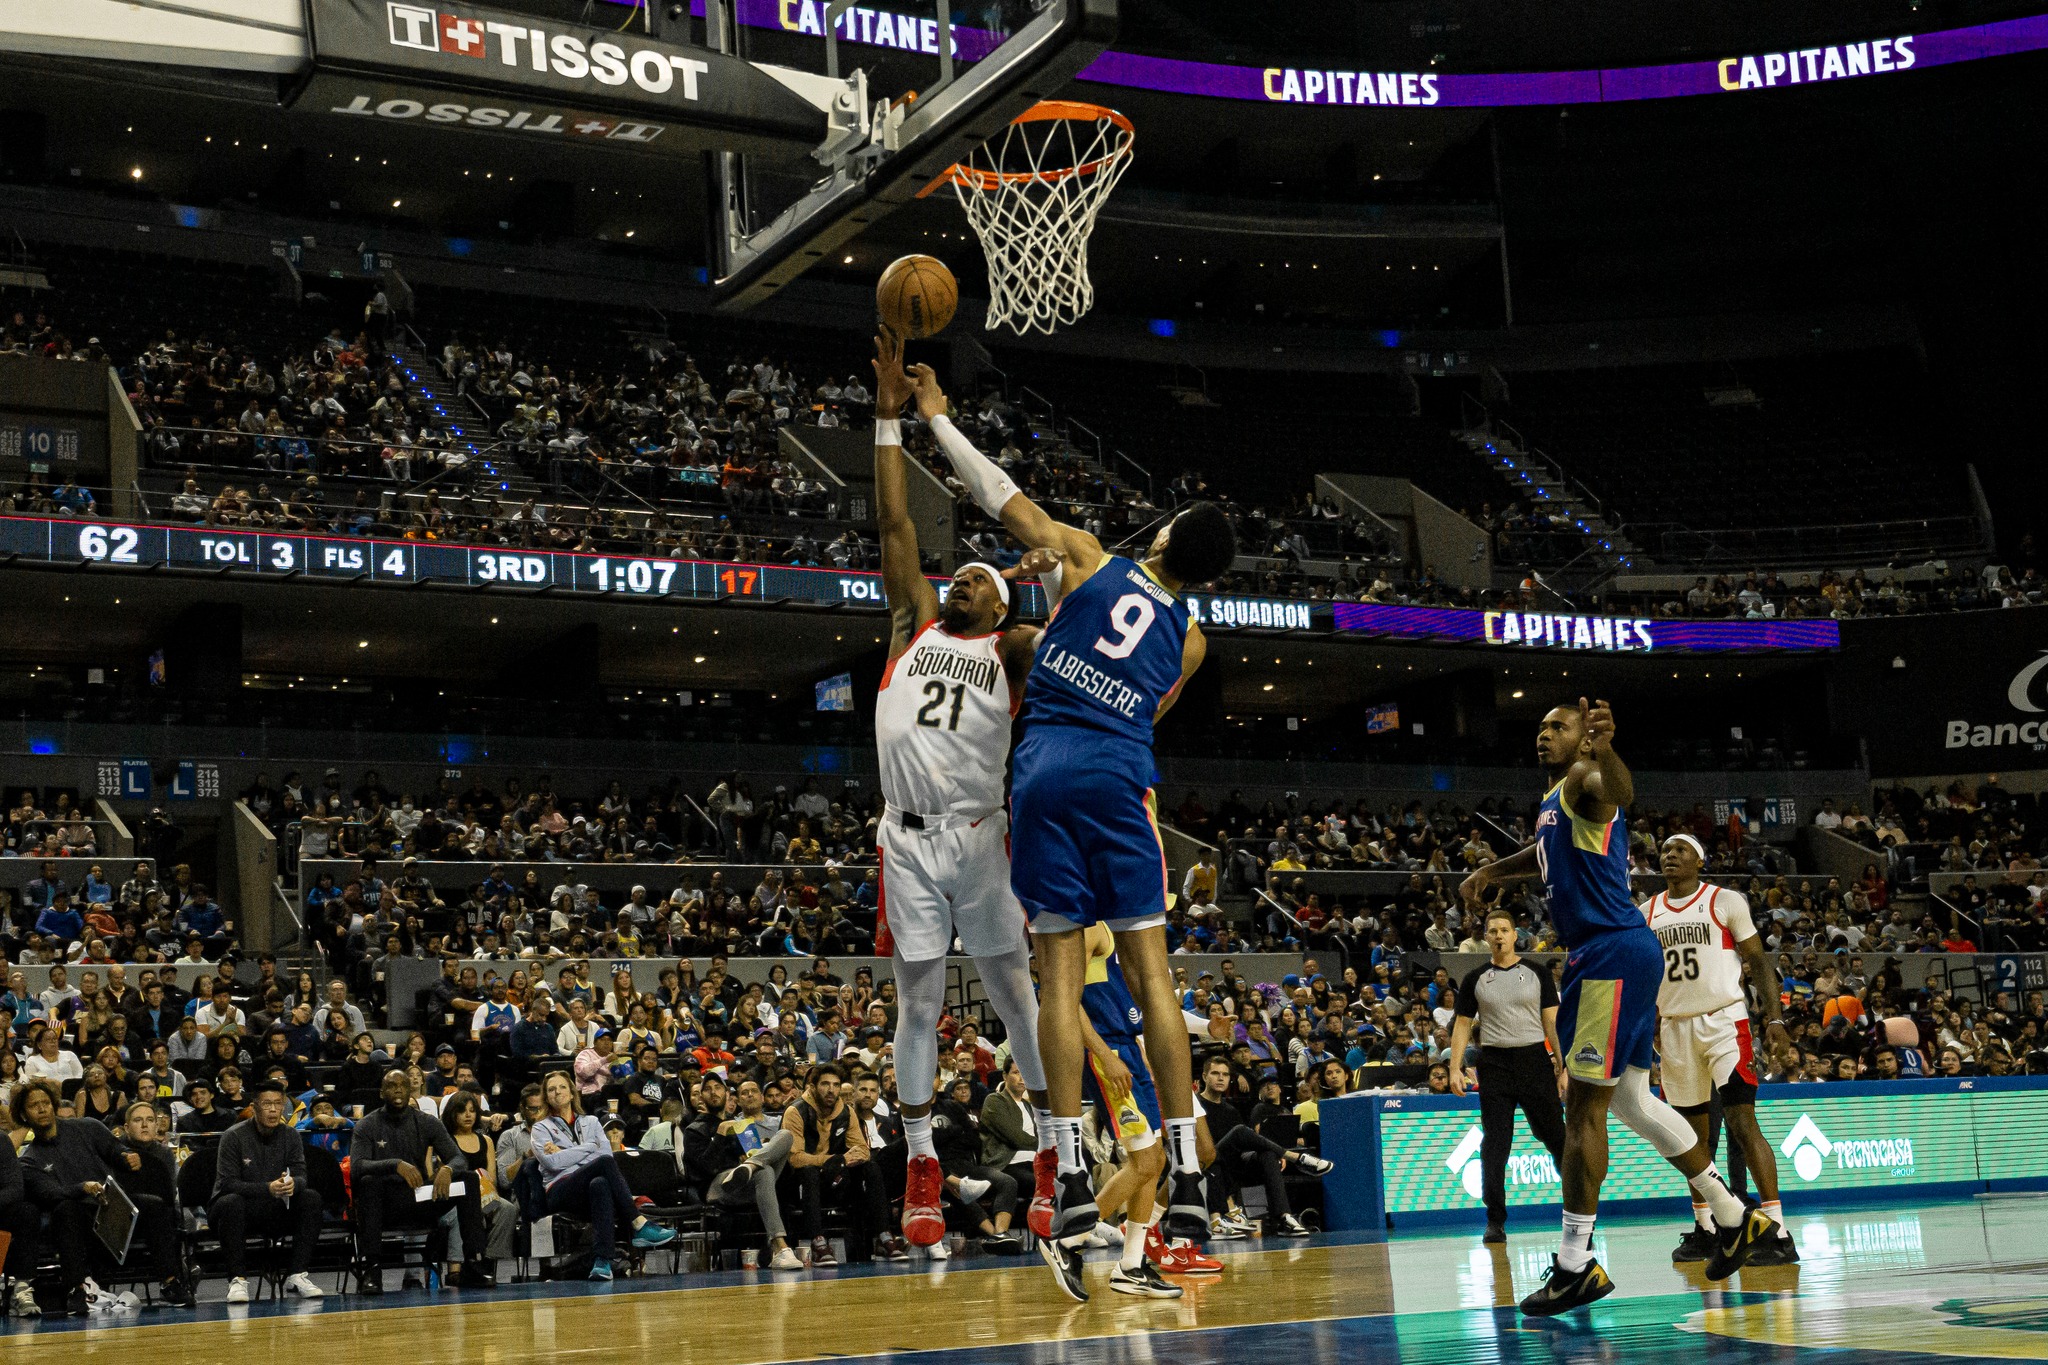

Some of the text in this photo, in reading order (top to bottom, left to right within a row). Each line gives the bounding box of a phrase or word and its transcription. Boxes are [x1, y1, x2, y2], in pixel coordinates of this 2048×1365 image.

[486, 21, 708, 101] TISSOT
[1718, 36, 1915, 91] CAPITANES
[1263, 67, 1439, 106] CAPITANES
[331, 96, 564, 134] TISSOT
[28, 432, 50, 454] 10
[79, 525, 139, 563] 62
[200, 539, 295, 570] TOL 3
[324, 547, 406, 576] FLS 4
[477, 554, 546, 583] 3RD
[589, 558, 677, 595] 1:07
[720, 570, 757, 595] 17
[839, 579, 880, 600] TOL
[1094, 593, 1156, 660] 9
[1211, 600, 1310, 630] SQUADRON
[1484, 611, 1653, 652] CAPITANES
[907, 646, 1001, 696] SQUADRON
[1041, 643, 1142, 719] LABISSIÉRE
[917, 680, 966, 731] 21
[97, 767, 120, 777] 213
[98, 776, 120, 786] 311
[128, 771, 145, 793] L
[197, 769, 219, 779] 214
[197, 778, 219, 788] 312
[445, 769, 462, 778] 373
[98, 786, 121, 796] 372
[197, 788, 220, 798] 373
[1763, 806, 1777, 823] N
[1666, 947, 1700, 982] 25
[2000, 959, 2017, 988] 2
[2024, 959, 2042, 970] 112
[2025, 974, 2044, 985] 113
[1905, 1049, 1917, 1067] 0
[1384, 1100, 1402, 1108] ANC
[1833, 1138, 1914, 1169] TECNOCASA
[1891, 1168, 1915, 1177] GROUP
